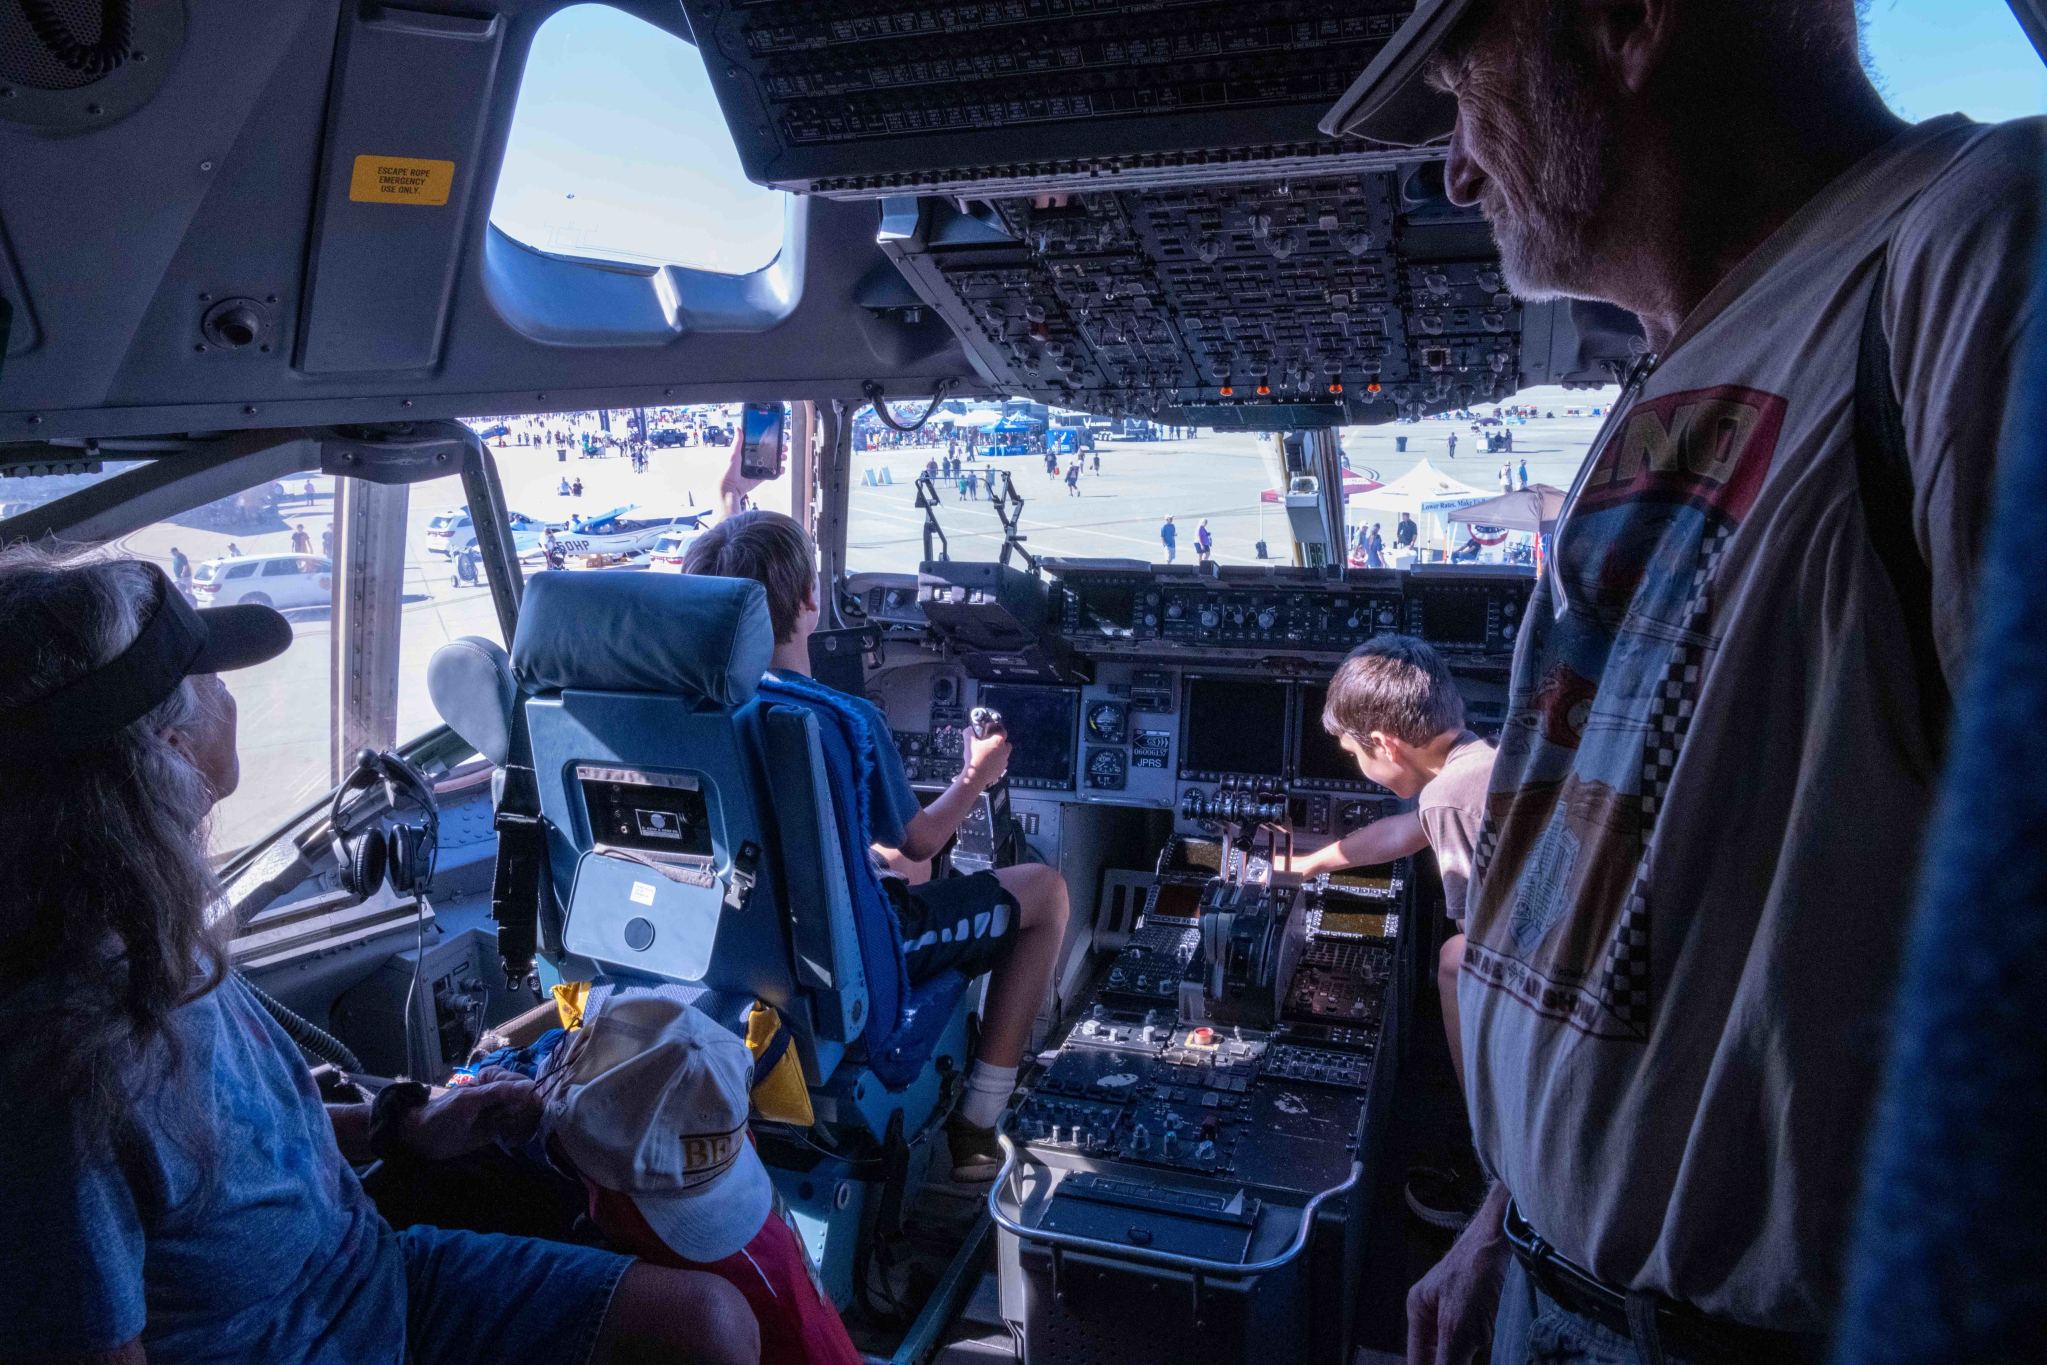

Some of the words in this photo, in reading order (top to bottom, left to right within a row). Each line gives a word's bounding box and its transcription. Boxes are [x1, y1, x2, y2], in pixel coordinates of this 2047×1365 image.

[377, 166, 408, 176] ESCAPE
[410, 168, 431, 177] ROPE
[378, 176, 426, 186] EMERGENCY
[381, 185, 397, 193] USE
[398, 186, 420, 195] ONLY
[1421, 502, 1440, 511] Lower
[1137, 758, 1162, 768] JPRS
